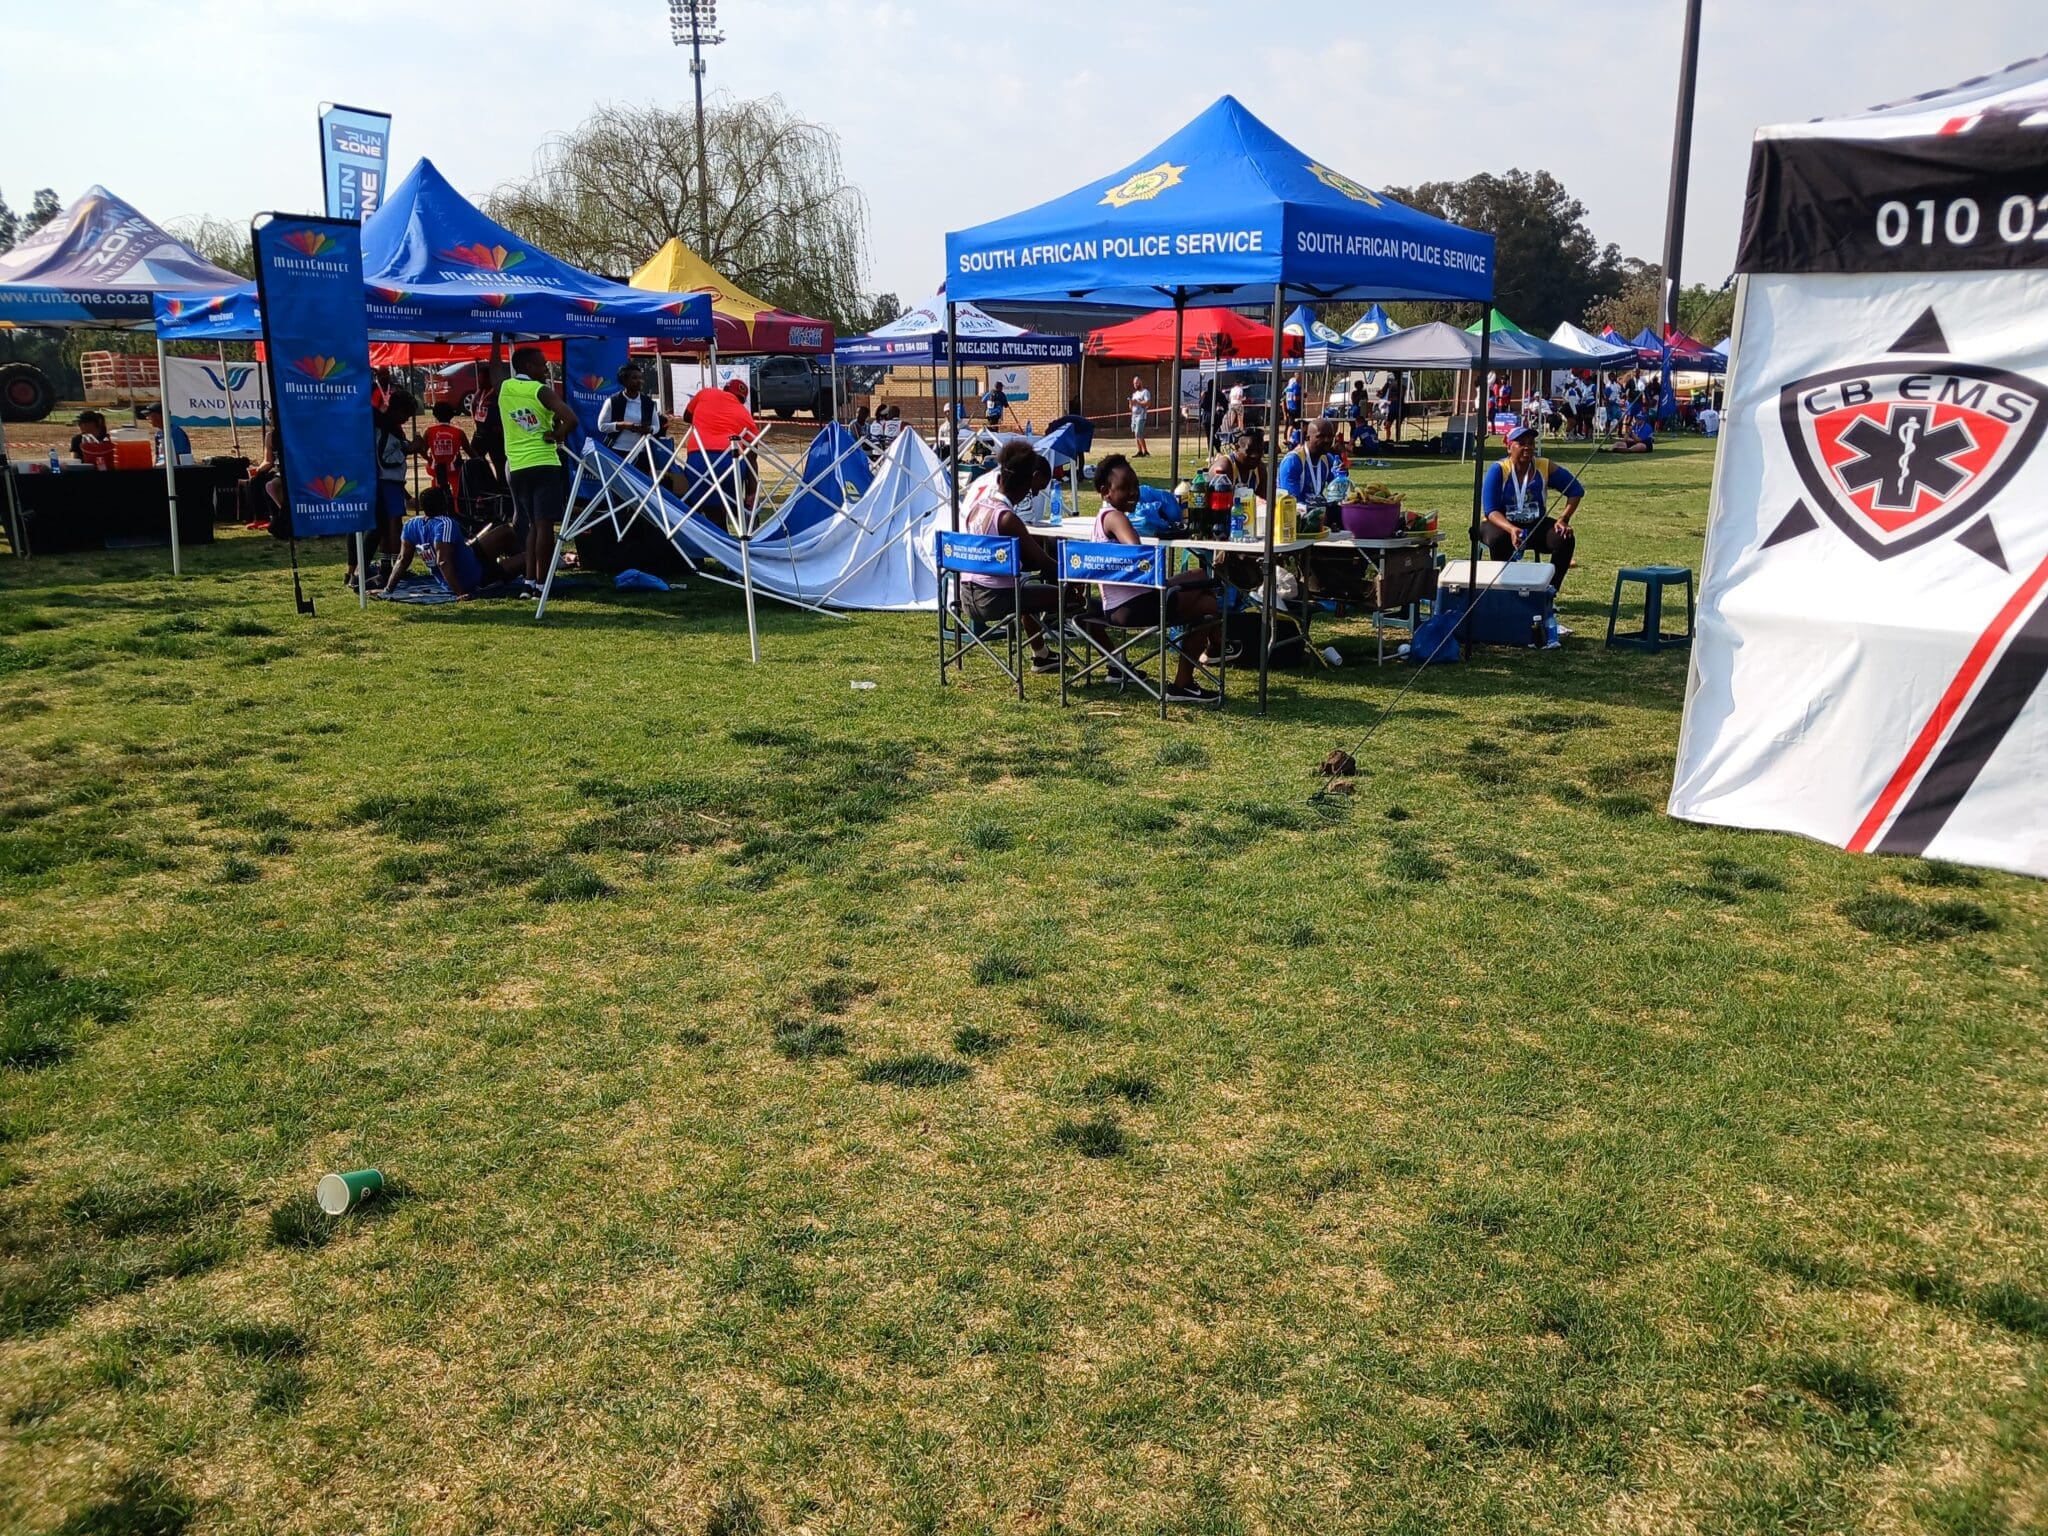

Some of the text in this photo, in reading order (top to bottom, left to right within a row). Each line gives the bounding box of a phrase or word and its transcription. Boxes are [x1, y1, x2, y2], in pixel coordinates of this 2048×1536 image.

[335, 139, 381, 157] ZONE
[344, 130, 381, 146] RUN
[360, 171, 378, 226] ONE
[1876, 198, 1980, 247] 010
[80, 217, 154, 268] ZONE
[959, 231, 1263, 273] SOUTH AFRICAN POLICE SERVICE
[1297, 231, 1486, 274] SOUTH AFRICAN POLICE SERVICE
[942, 341, 1073, 357] ITMELENG ATHLETIC CLUB
[189, 398, 226, 409] RAND
[1804, 375, 2032, 424] CB EMS
[1083, 555, 1104, 563] SOUTH
[1083, 562, 1105, 570] POLICE
